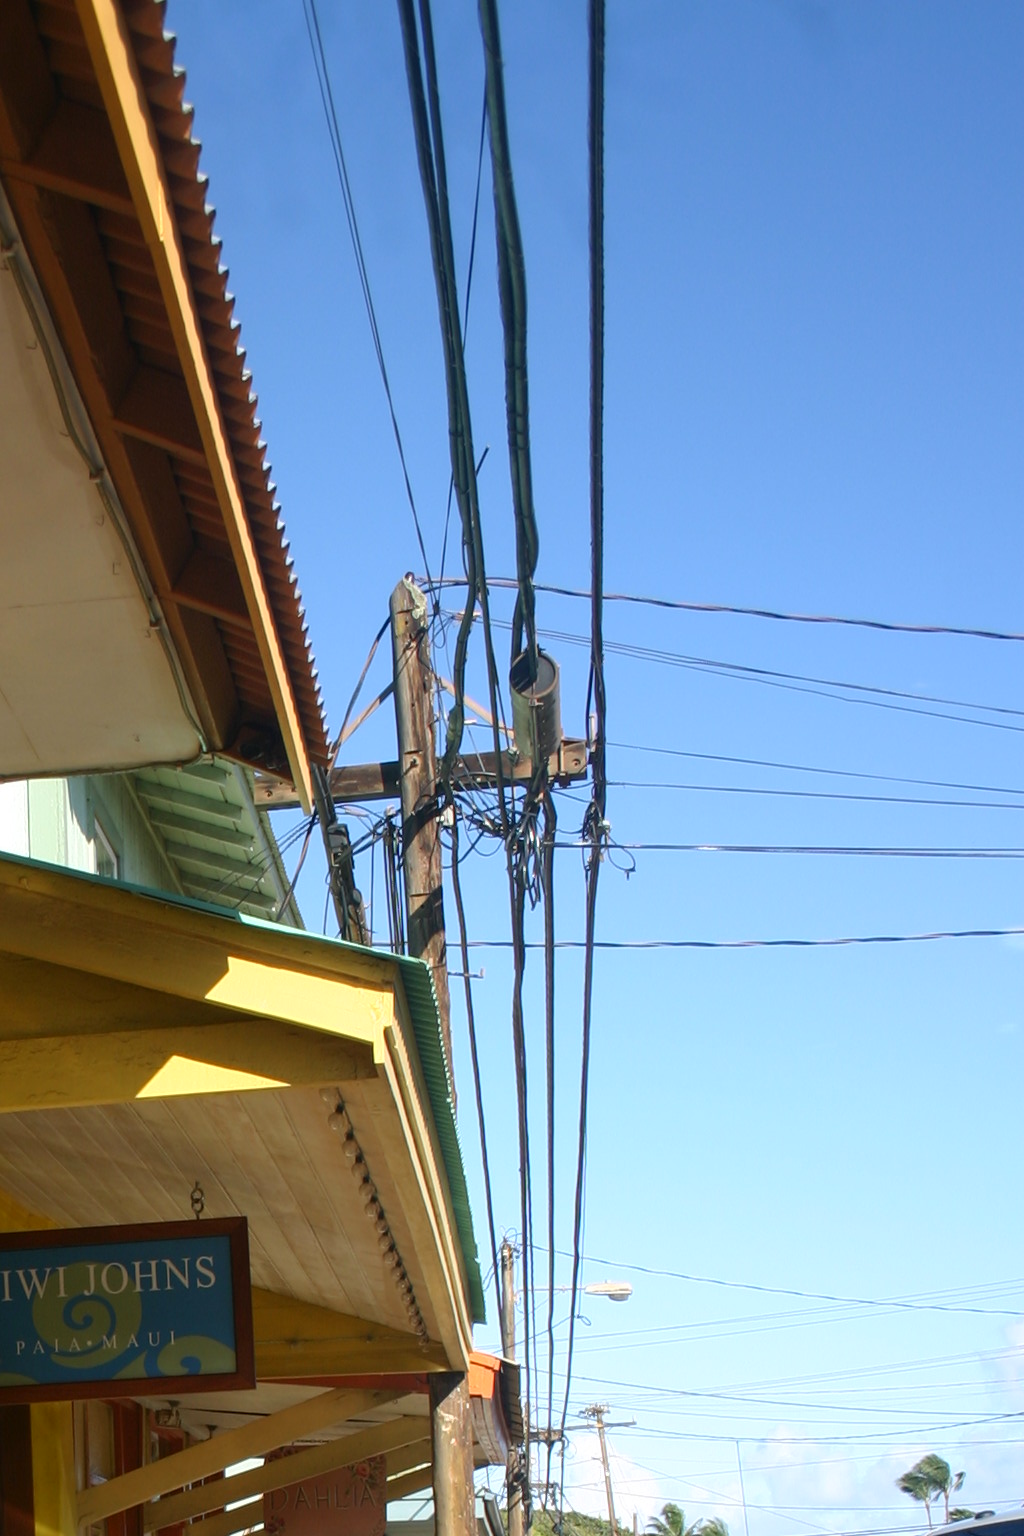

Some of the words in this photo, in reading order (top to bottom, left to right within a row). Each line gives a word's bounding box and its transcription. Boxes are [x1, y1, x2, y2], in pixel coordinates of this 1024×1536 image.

[83, 1255, 216, 1297] JOHNS
[16, 1336, 81, 1355] PAIA
[102, 1330, 176, 1349] MAUI
[270, 1481, 376, 1511] DAHLIA
